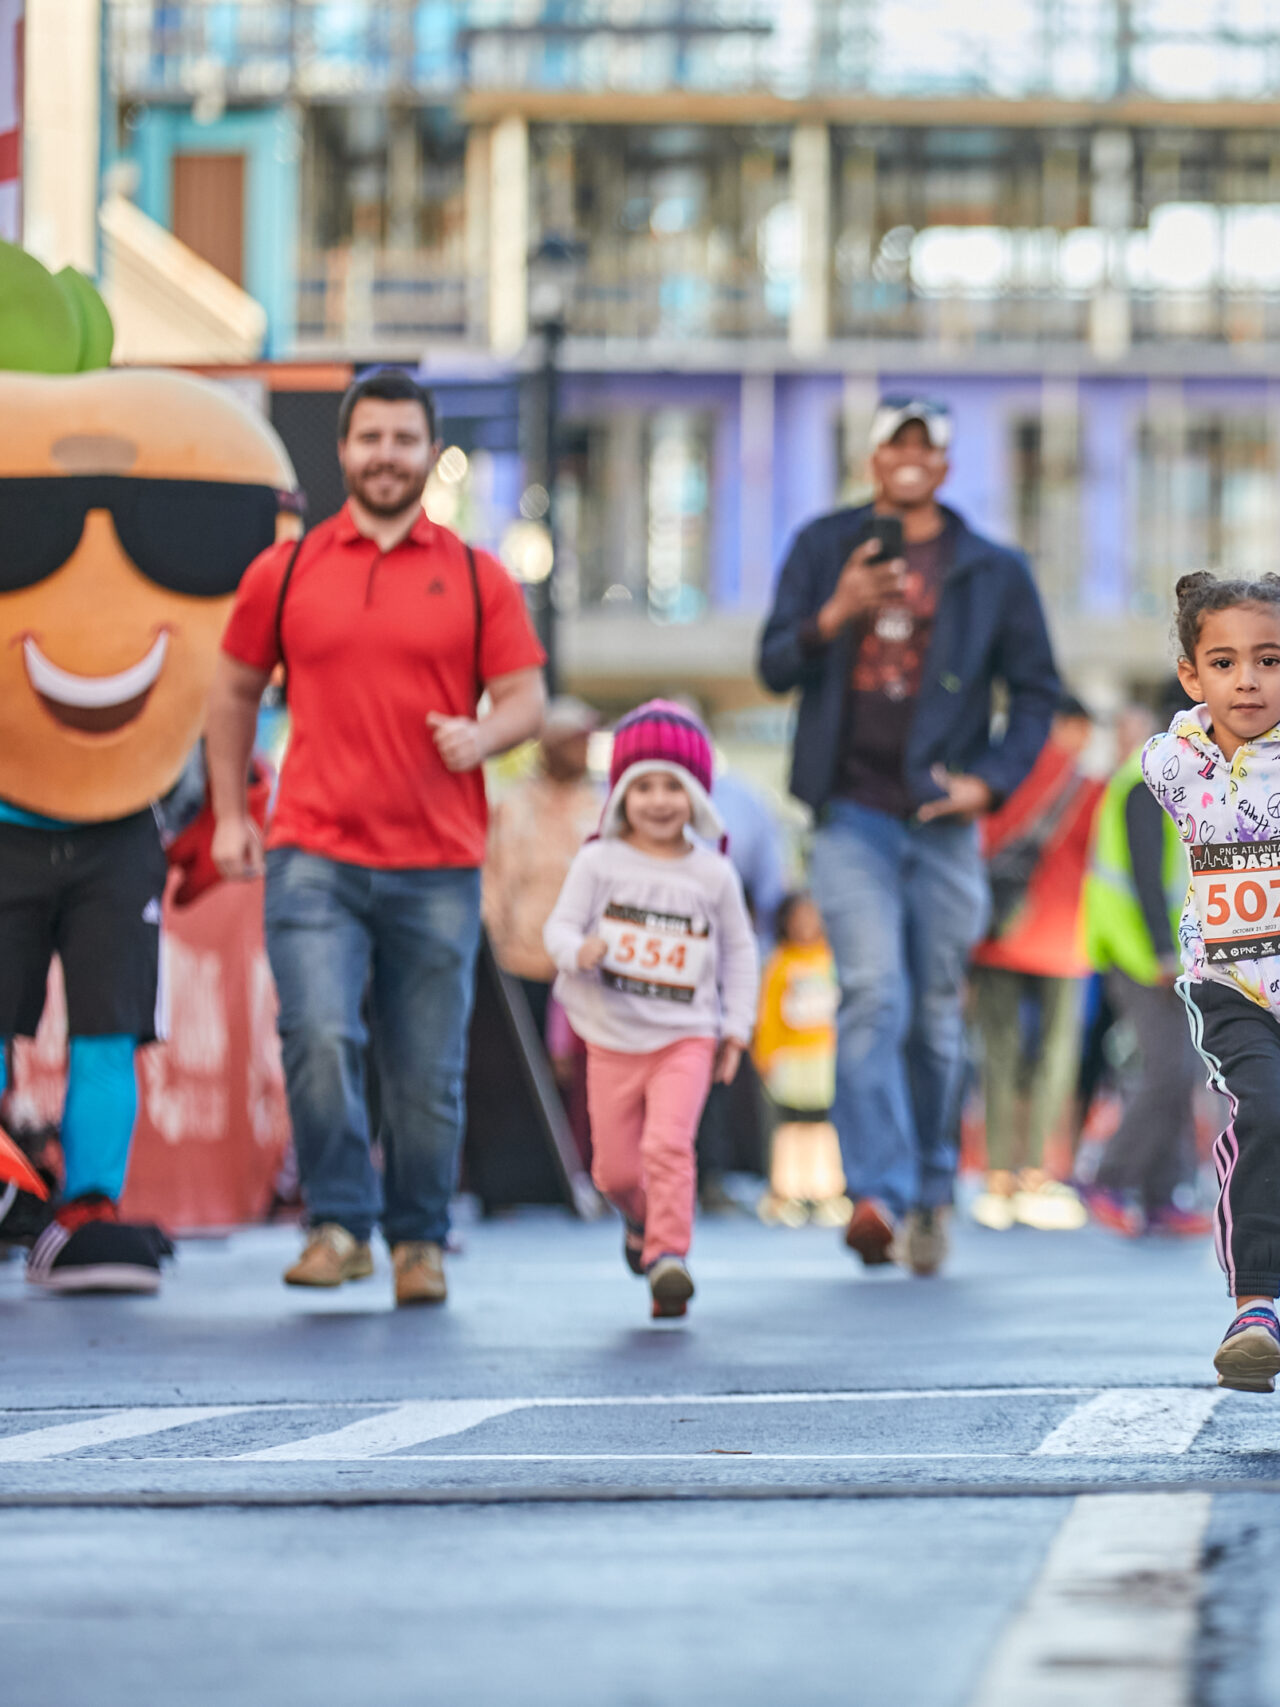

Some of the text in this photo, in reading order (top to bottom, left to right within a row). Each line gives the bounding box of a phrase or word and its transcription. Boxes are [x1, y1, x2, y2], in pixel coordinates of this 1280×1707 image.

[1172, 786, 1187, 803] Be
[1238, 799, 1270, 834] Happy
[1219, 847, 1238, 856] PNC
[614, 933, 687, 974] 554
[1240, 946, 1258, 955] PNC
